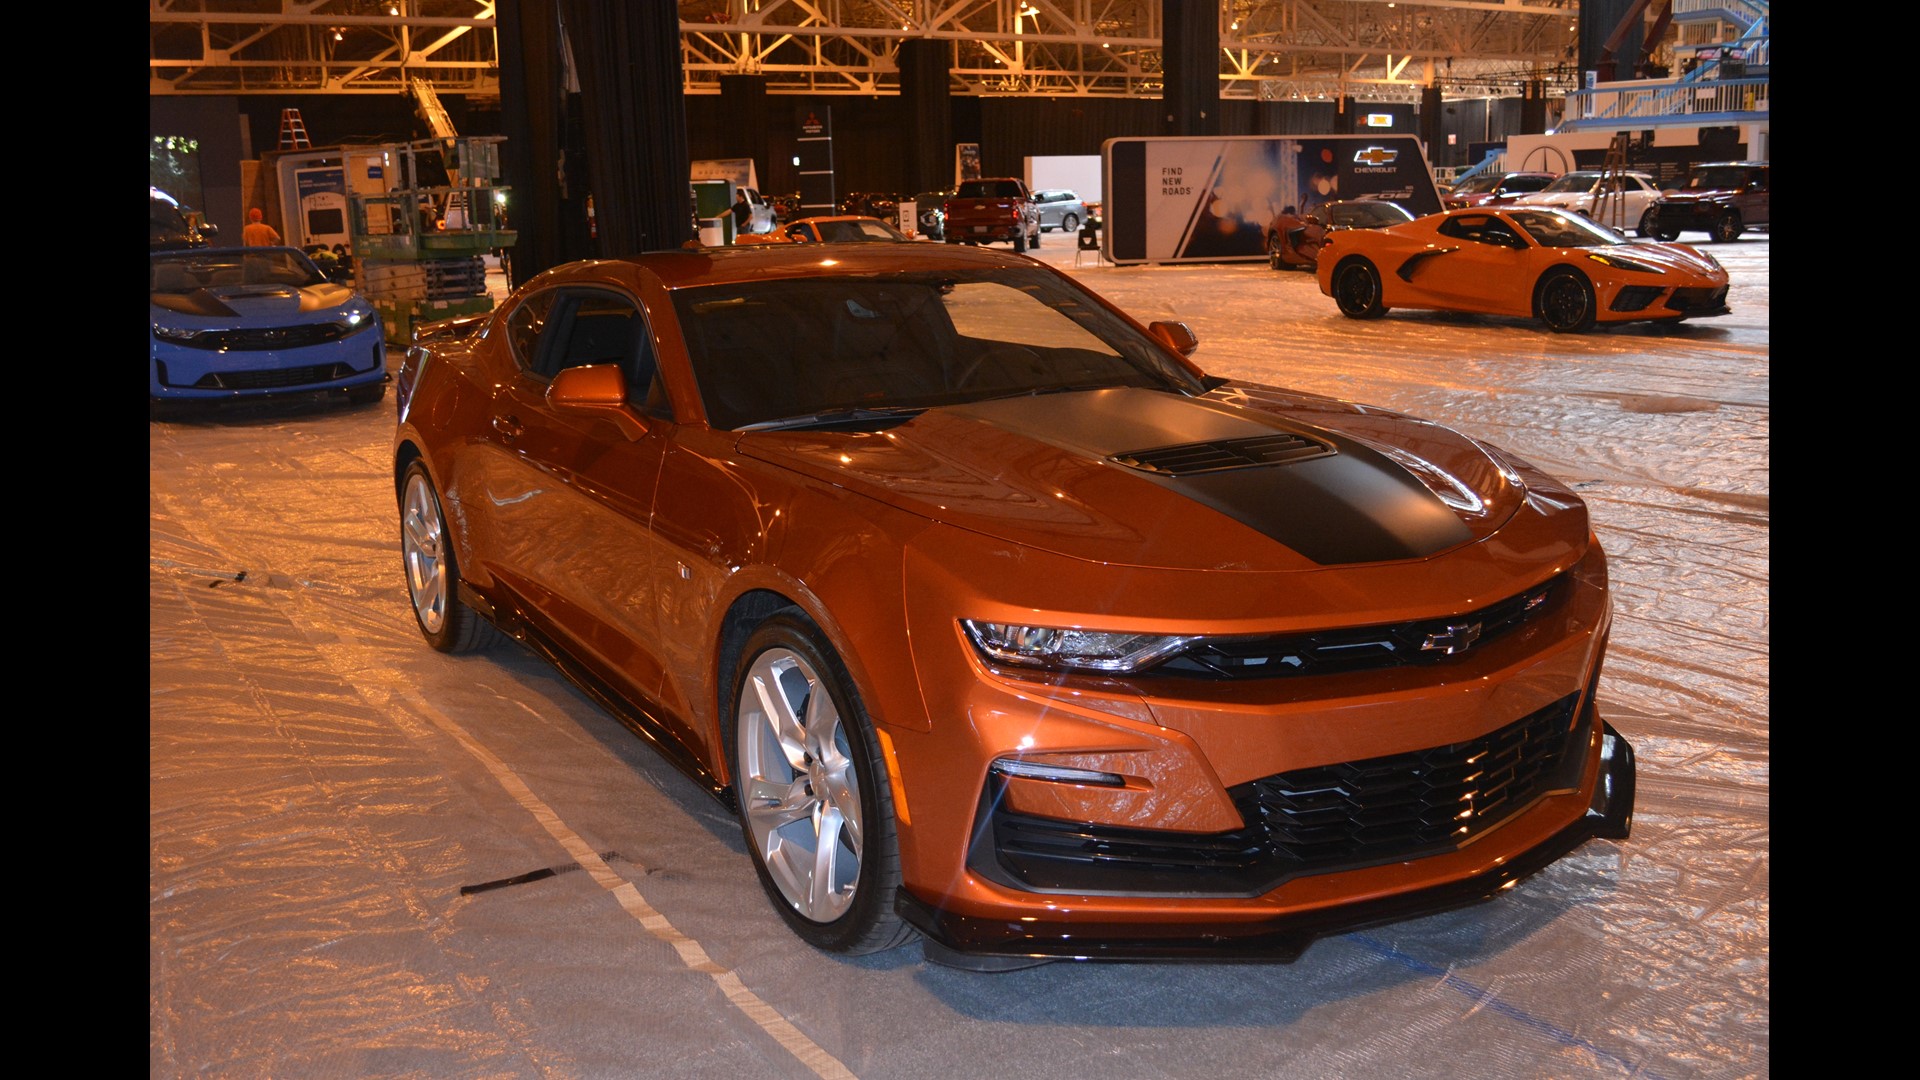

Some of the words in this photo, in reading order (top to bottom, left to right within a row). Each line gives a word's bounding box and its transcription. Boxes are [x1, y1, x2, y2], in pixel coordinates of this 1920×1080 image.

[1162, 167, 1183, 175] FIND
[1162, 177, 1182, 185] NEW
[1162, 187, 1191, 195] ROADS
